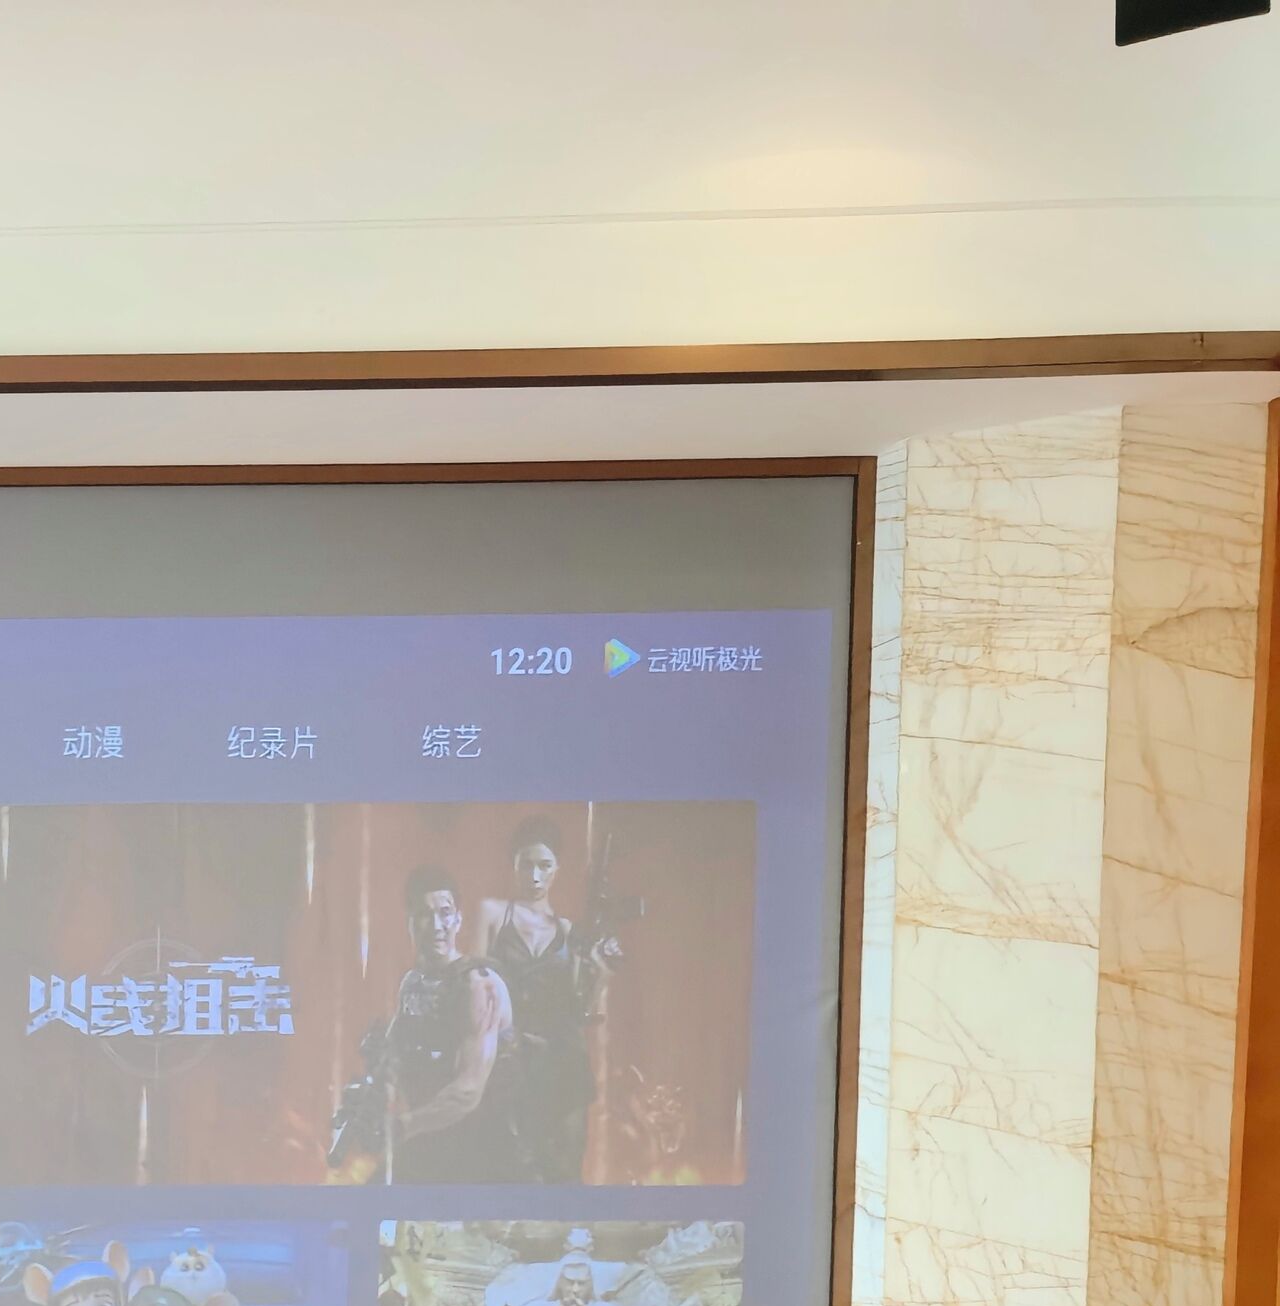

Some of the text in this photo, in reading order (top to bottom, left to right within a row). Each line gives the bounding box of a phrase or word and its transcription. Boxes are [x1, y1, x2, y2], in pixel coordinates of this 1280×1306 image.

[490, 646, 573, 676] 12:20
[647, 643, 764, 674] 云视听极光
[62, 725, 125, 760] 动漫
[227, 726, 318, 760] 纪录片
[421, 724, 483, 760] 综艺
[27, 972, 295, 1036] 火线狙击
